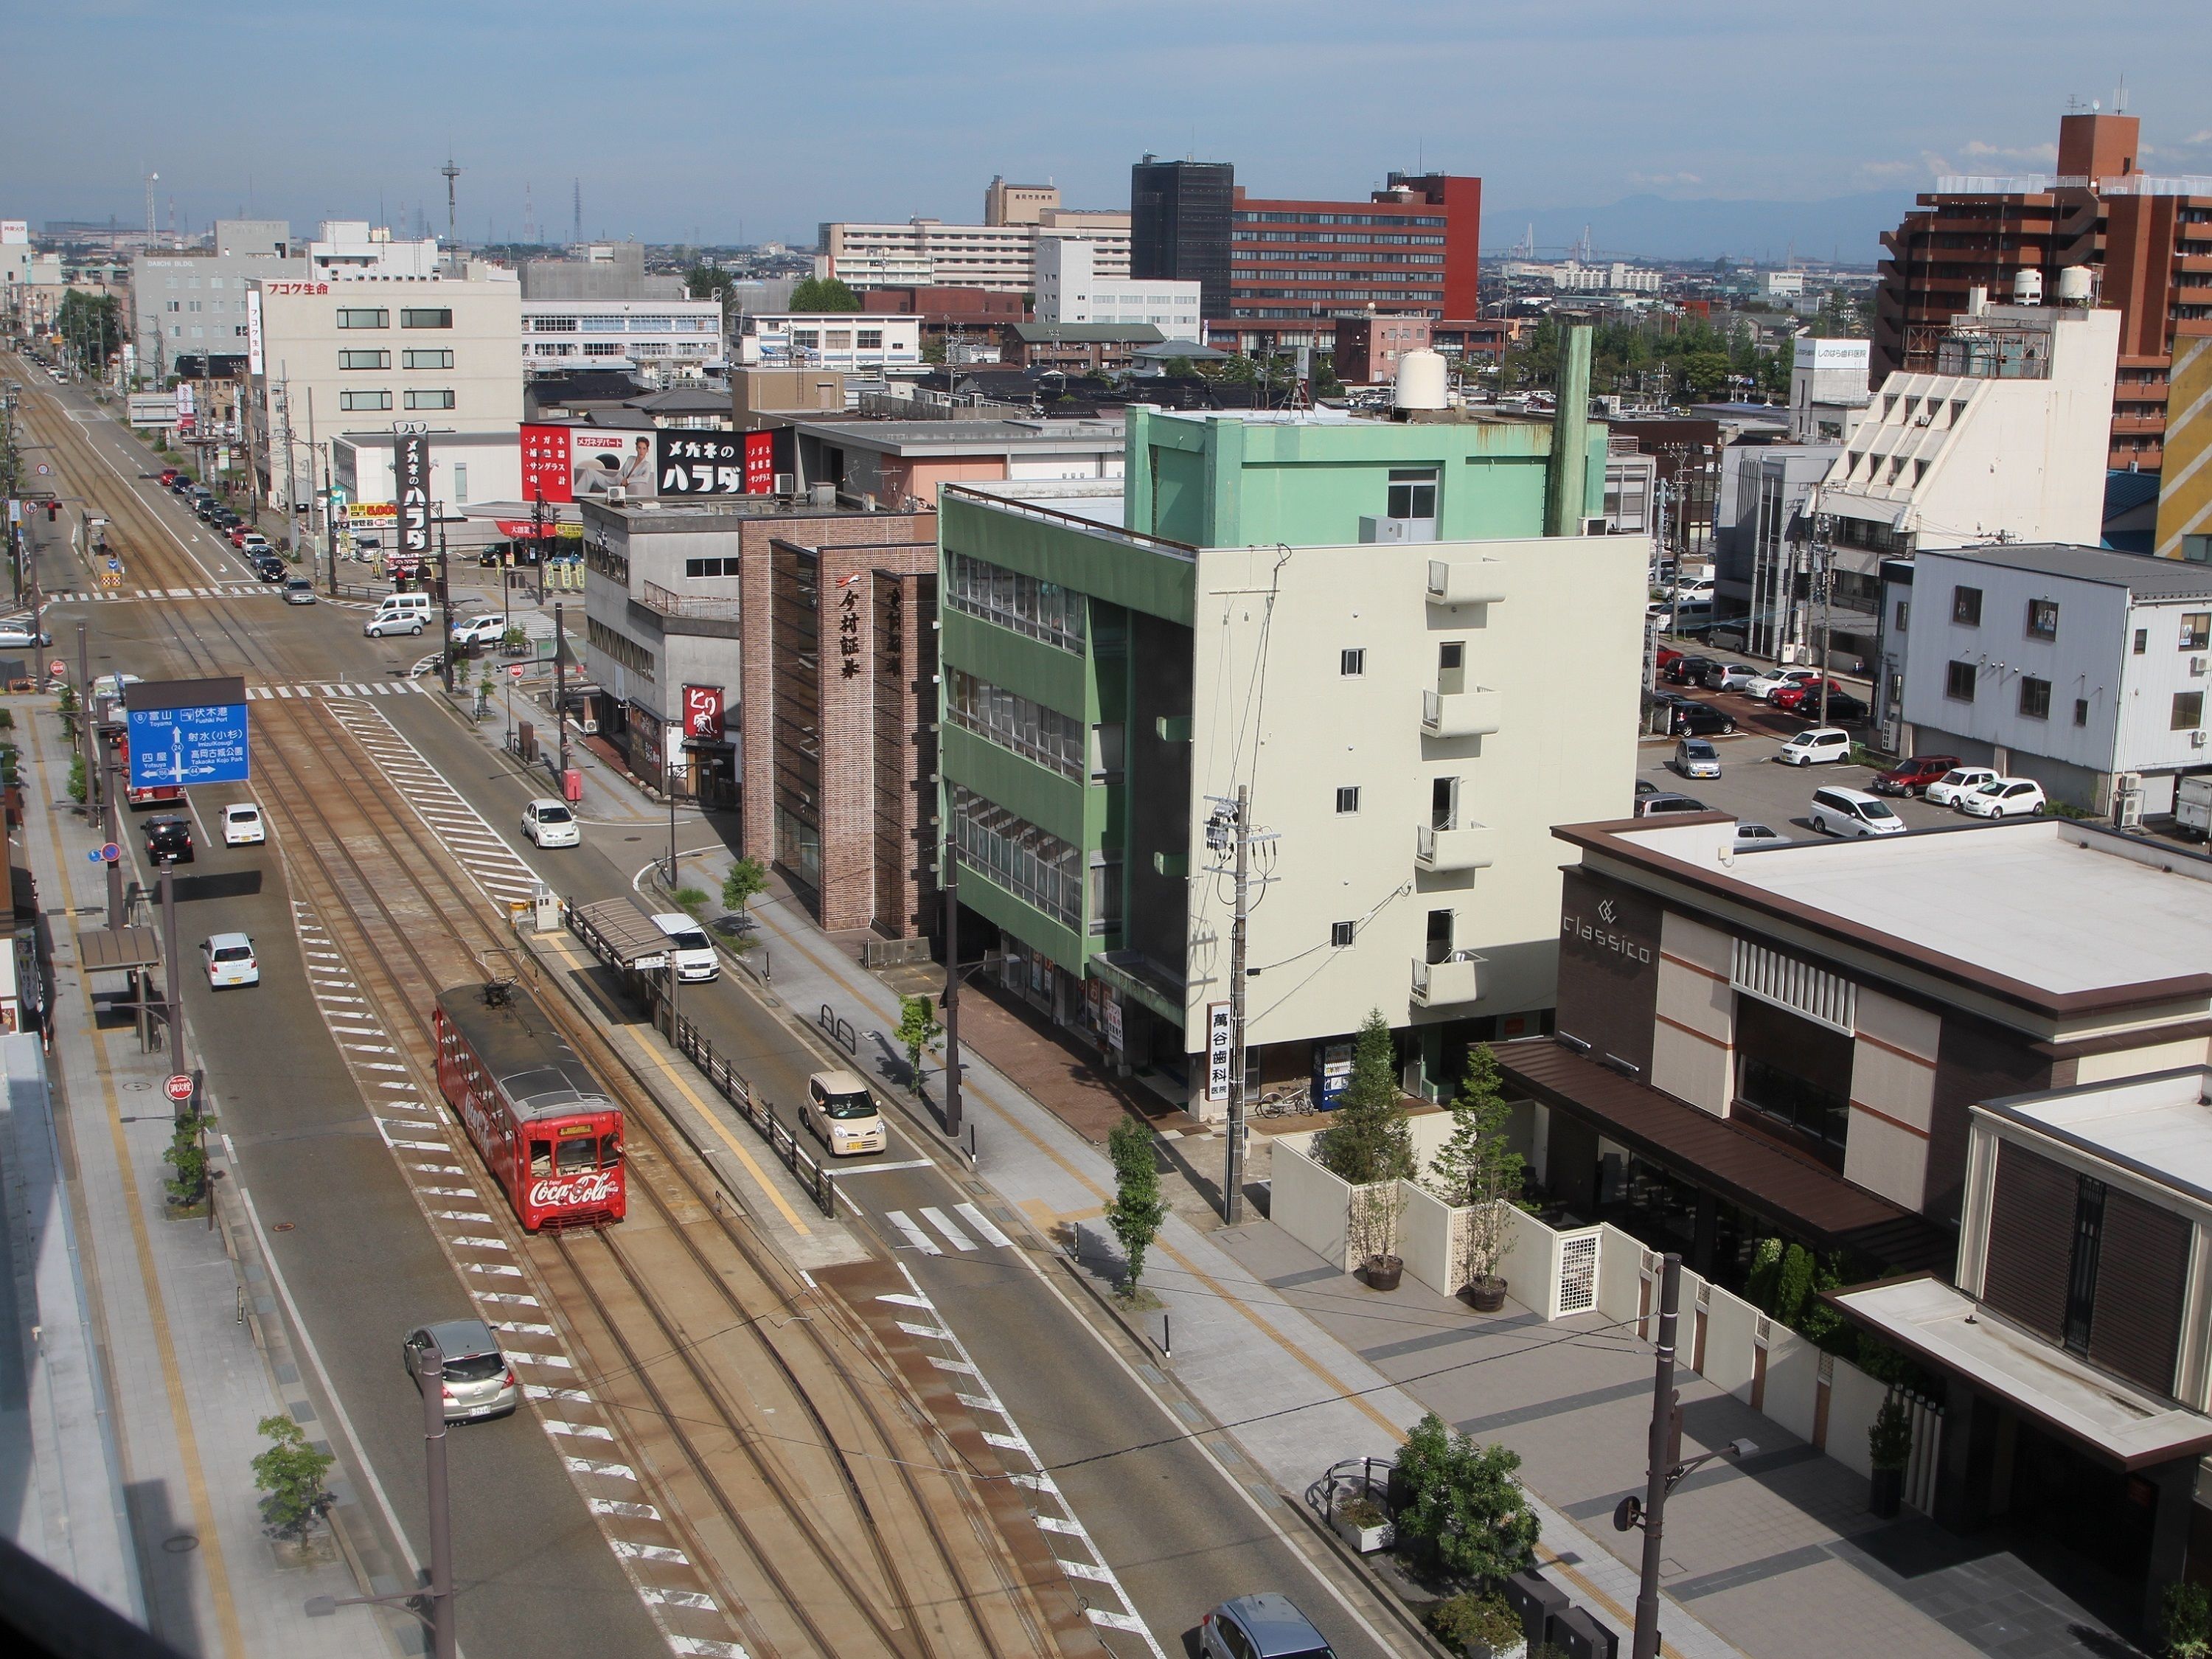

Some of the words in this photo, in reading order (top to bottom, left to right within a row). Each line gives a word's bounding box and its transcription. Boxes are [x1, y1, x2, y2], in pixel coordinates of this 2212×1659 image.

[267, 283, 329, 295] フコク生命
[251, 309, 260, 357] フコク生命
[1818, 349, 1867, 358] しのはら歯科医院
[577, 438, 622, 447] メガネデパート
[669, 441, 734, 459] メガネの
[663, 464, 741, 493] ハラダ
[403, 440, 426, 550] メガネのハラダ
[149, 711, 171, 720] 富山
[195, 707, 228, 718] 伏木港
[142, 752, 167, 762] 四屋
[191, 746, 243, 759] 高岡古城公園
[1563, 917, 1649, 964] classico
[1212, 1013, 1228, 1083] 萬谷歯科
[170, 1082, 191, 1093] 消火栓
[1211, 1085, 1227, 1094] 医院
[529, 1171, 611, 1207] Coca-Cola
